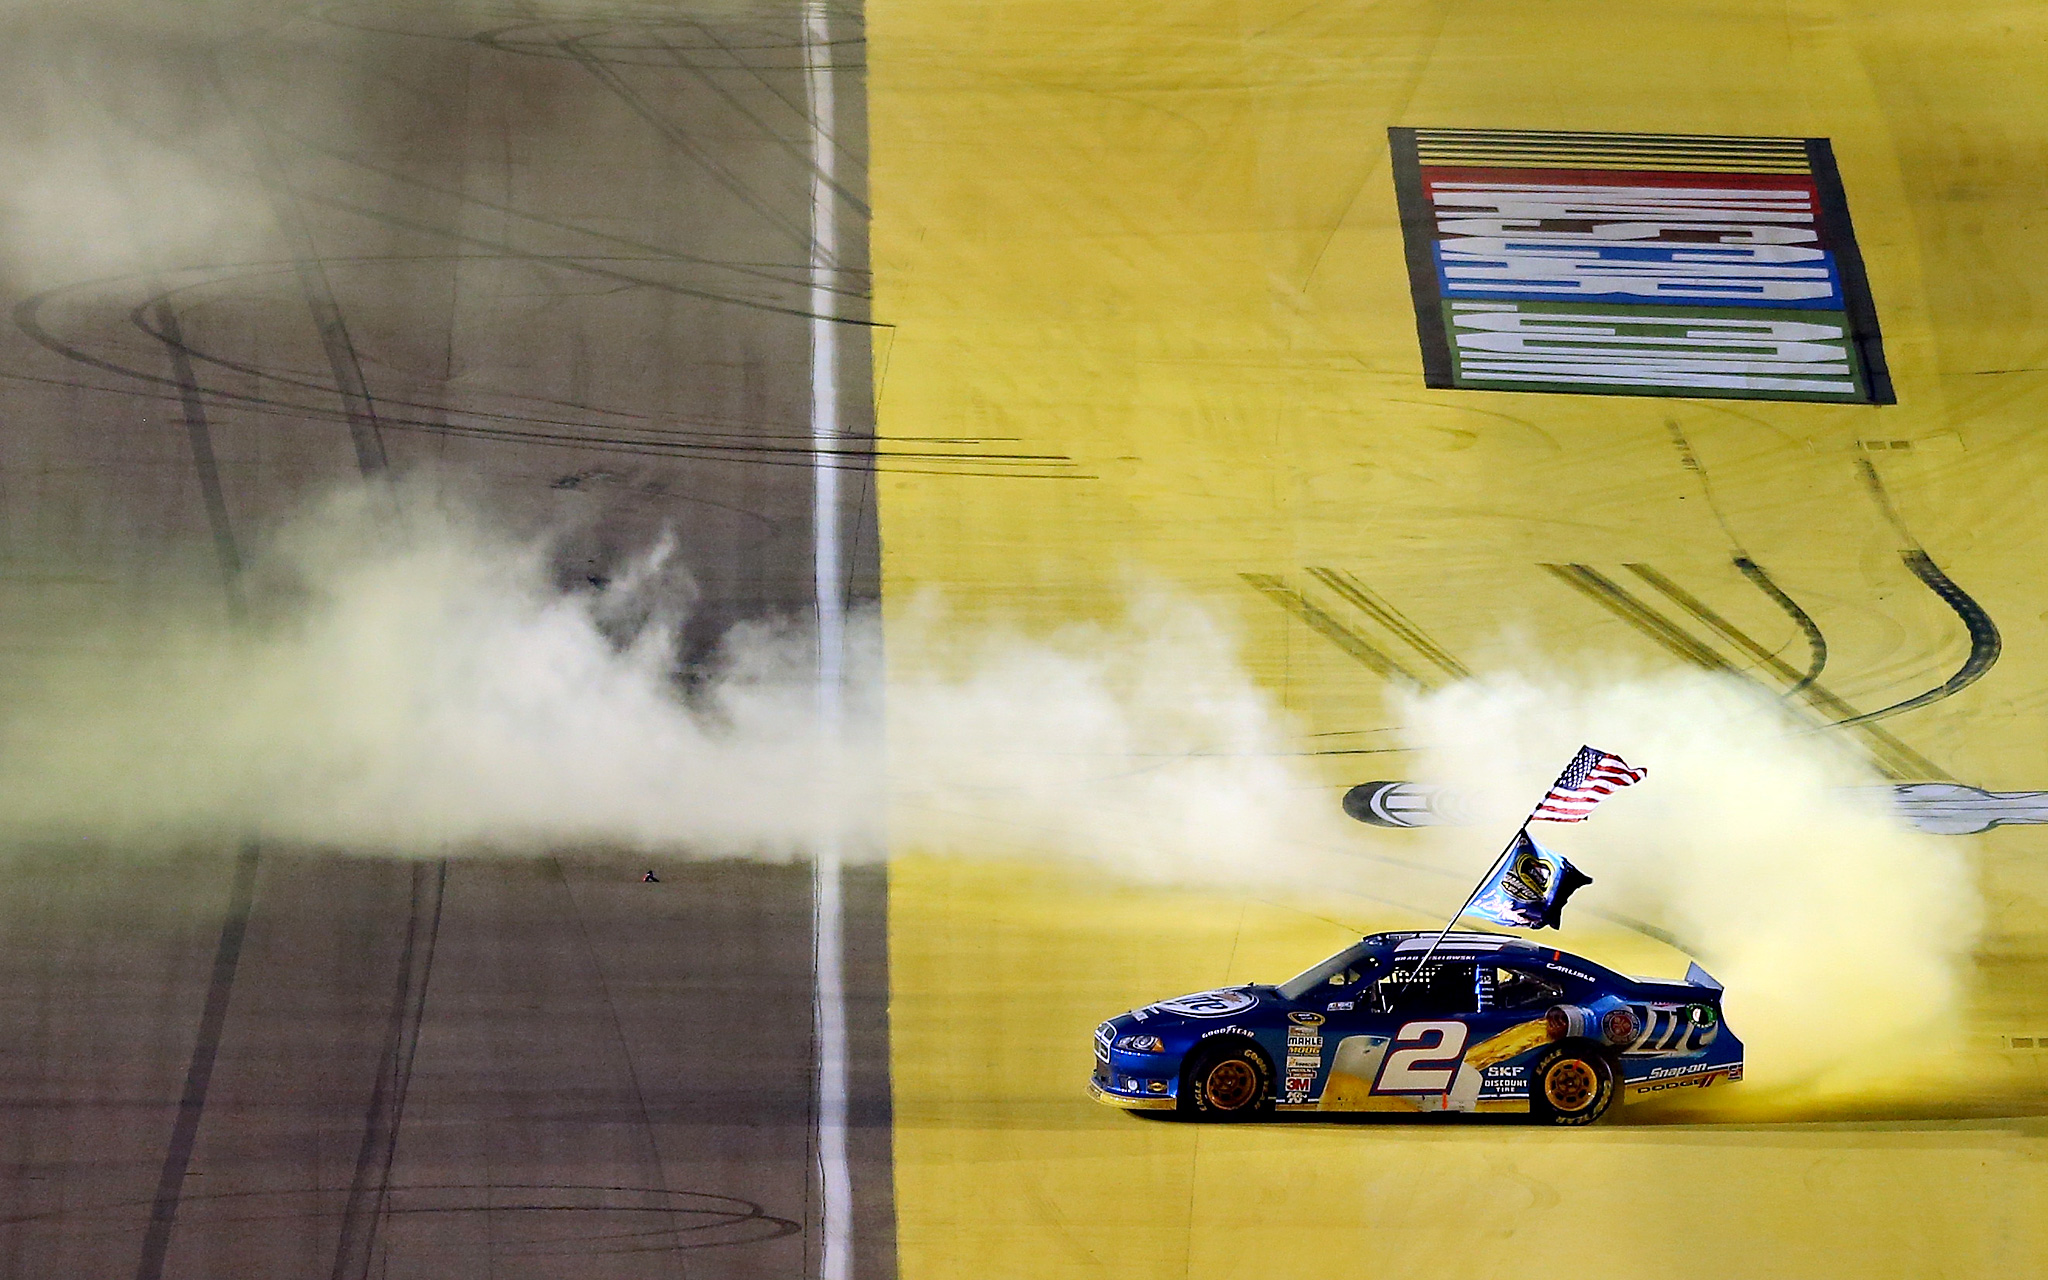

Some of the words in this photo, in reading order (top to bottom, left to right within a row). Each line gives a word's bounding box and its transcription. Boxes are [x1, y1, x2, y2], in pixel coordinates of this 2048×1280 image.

[1430, 181, 1855, 393] NASCAR.COM
[1546, 962, 1596, 983] CARLISLE
[1288, 1037, 1322, 1045] MAHLE
[1369, 1019, 1469, 1095] 2
[1535, 1048, 1562, 1075] EAGLE
[1487, 1066, 1525, 1077] SKF
[1650, 1063, 1708, 1078] Snap-on
[1287, 1078, 1309, 1091] 3M
[1484, 1079, 1528, 1087] DISCOUNT
[1194, 1080, 1207, 1111] EAGLE
